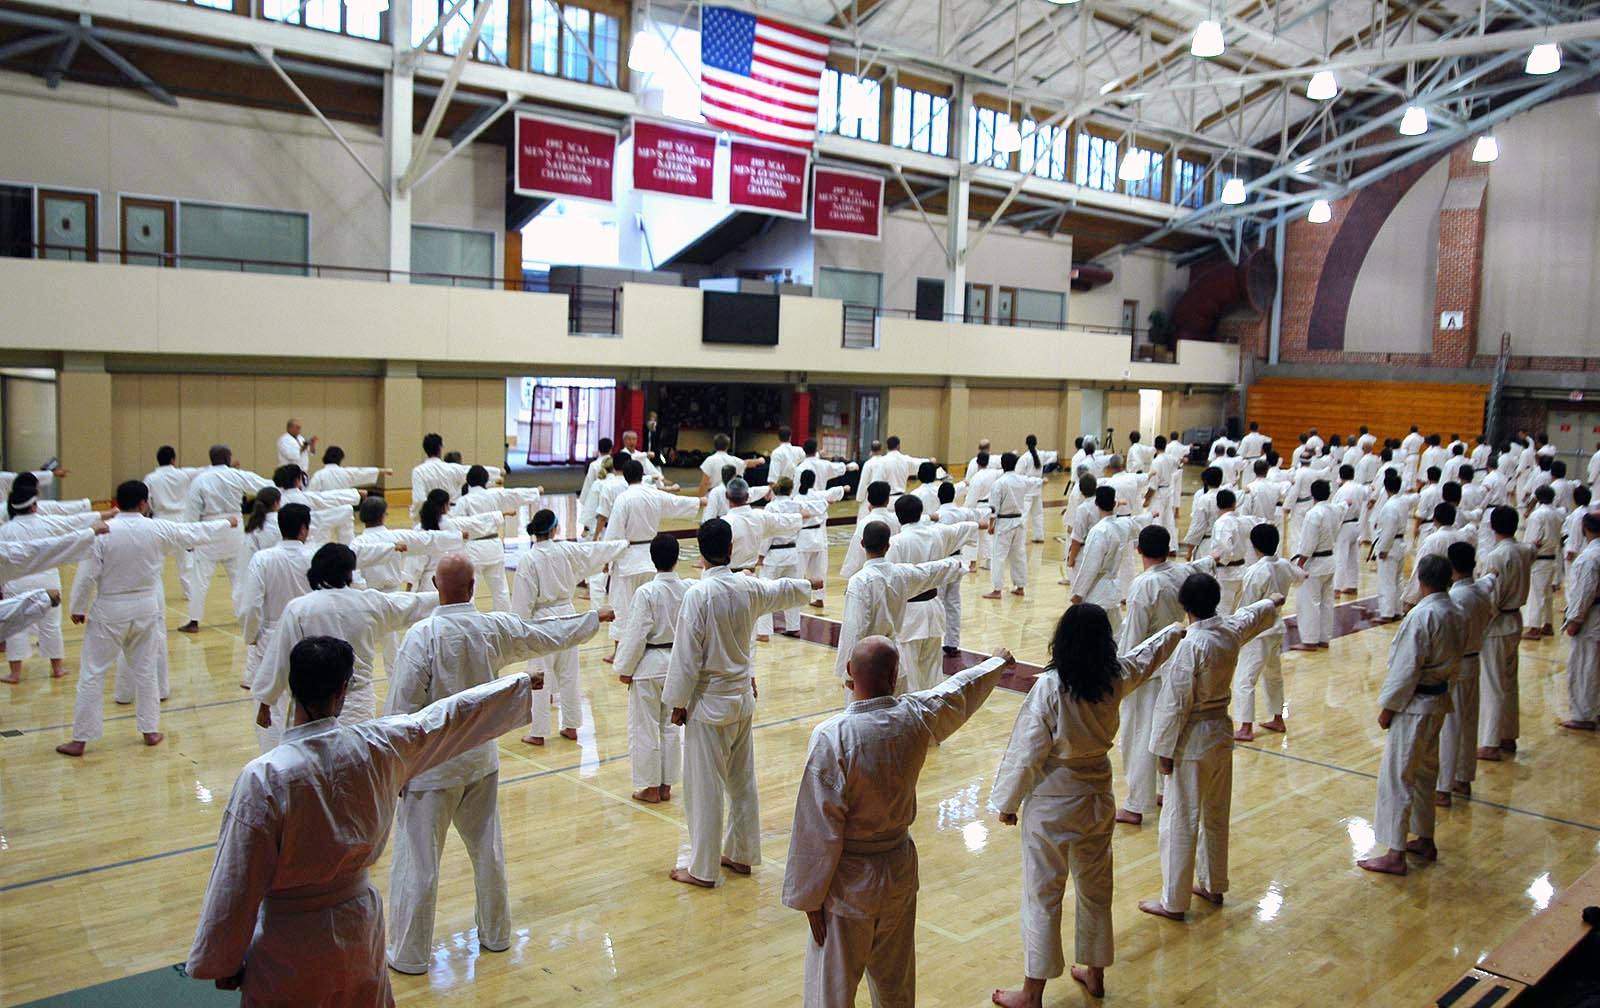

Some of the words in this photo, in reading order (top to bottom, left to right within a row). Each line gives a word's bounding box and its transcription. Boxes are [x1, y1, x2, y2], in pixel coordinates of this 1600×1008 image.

[566, 142, 589, 155] NCAA
[675, 143, 695, 155] NCAA
[545, 158, 587, 174] NATIONAL
[555, 151, 610, 169] GYMNASTICS
[657, 159, 692, 174] NATIONAL
[665, 151, 711, 168] GYMNASTICS
[767, 160, 785, 172] NCAA
[541, 168, 592, 185] CHAMPIONS
[652, 167, 697, 184] CHAMPIONS
[750, 175, 783, 189] NATIONAL
[757, 169, 801, 185] GYMNASTICS
[747, 184, 787, 199] CHAMPIONS
[832, 202, 862, 214] NATIONAL
[829, 210, 865, 223] CHAMPIONS
[1446, 315, 1456, 330] A
